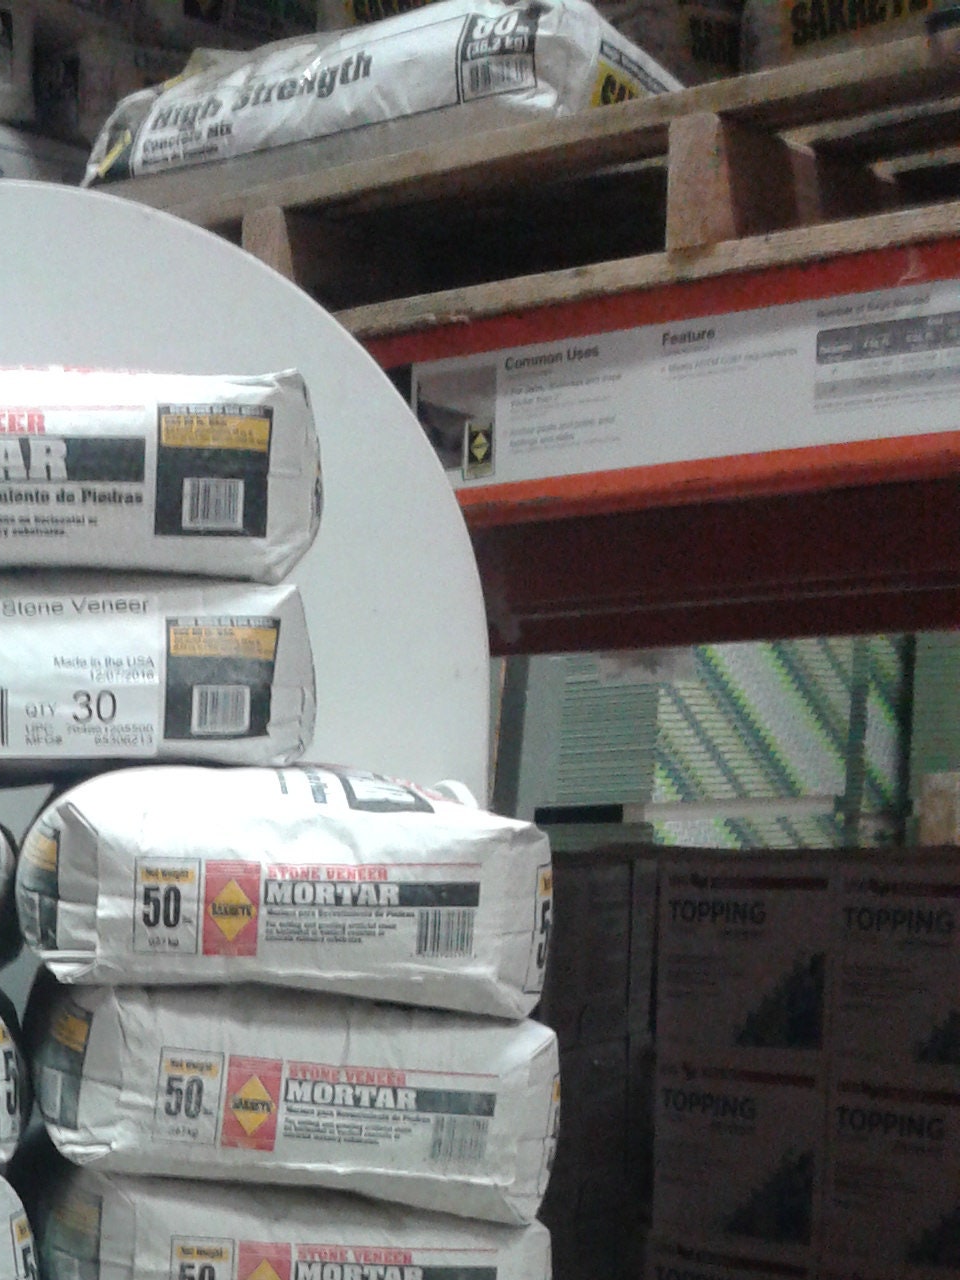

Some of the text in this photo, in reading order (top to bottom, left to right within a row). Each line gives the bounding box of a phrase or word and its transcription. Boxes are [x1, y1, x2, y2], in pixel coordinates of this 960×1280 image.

[790, 0, 928, 46] SAKRE
[662, 327, 715, 347] Feature
[504, 345, 600, 371] Common Uses
[56, 488, 76, 503] de
[81, 488, 143, 504] Piedras
[71, 597, 150, 616] Veneer
[127, 655, 155, 668] USA
[25, 689, 117, 724] QTY 30
[268, 865, 388, 881] STONE VENEER
[142, 885, 182, 928] 50
[266, 881, 399, 906] MORTAR
[669, 898, 767, 926] TOPPING
[843, 905, 956, 935] TOPPING
[164, 1075, 204, 1119] 50
[286, 1079, 418, 1109] MORTAR
[662, 1086, 757, 1121] TOPPING
[836, 1104, 946, 1141] TOPPING
[296, 1247, 347, 1263] STONE
